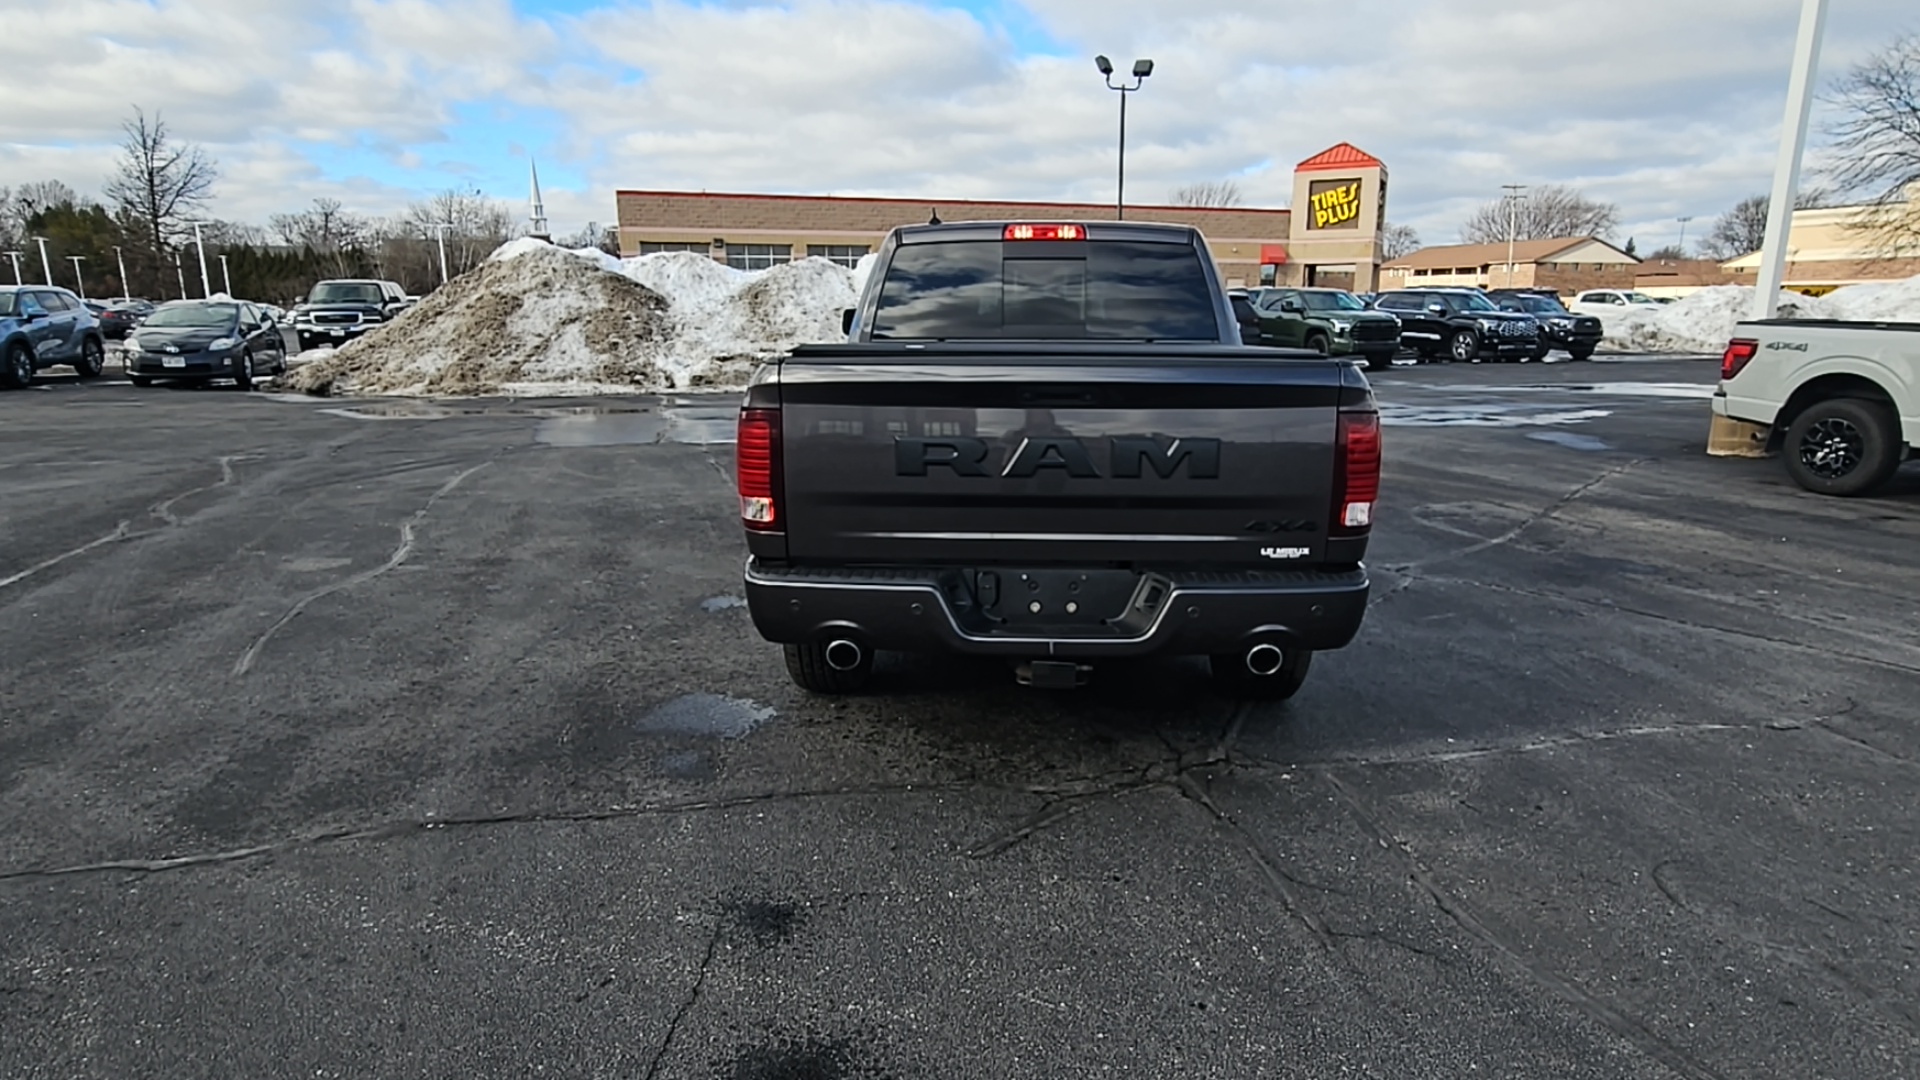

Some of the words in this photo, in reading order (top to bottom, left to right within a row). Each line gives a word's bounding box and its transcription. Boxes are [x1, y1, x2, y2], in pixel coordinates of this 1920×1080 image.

[1311, 182, 1357, 210] TIRES
[1316, 199, 1358, 227] PLUS
[894, 437, 1221, 479] RAM
